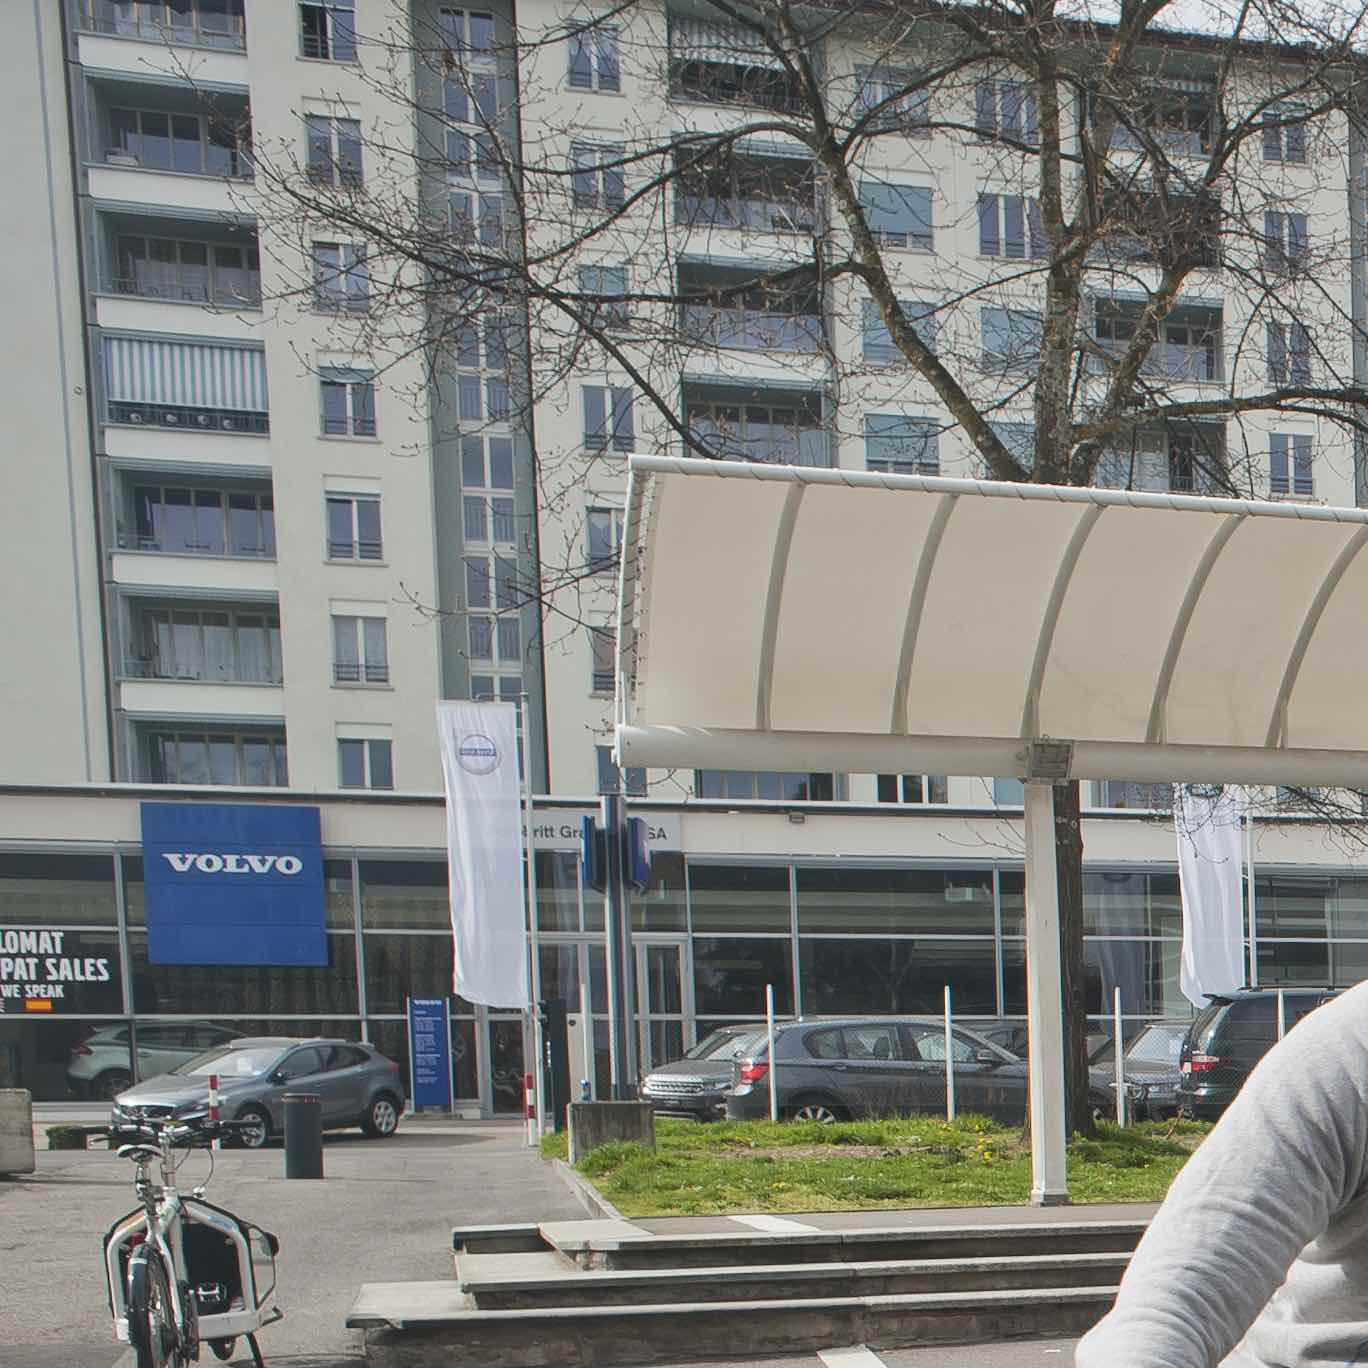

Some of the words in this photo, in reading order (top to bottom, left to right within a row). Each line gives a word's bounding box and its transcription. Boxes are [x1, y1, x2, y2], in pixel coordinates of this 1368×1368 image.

[161, 853, 303, 875] VOLVO
[0, 930, 65, 955] LOMAT
[0, 957, 39, 981] PAT
[45, 957, 110, 982] SALES
[0, 983, 22, 998] WE
[24, 983, 65, 998] SPEAK
